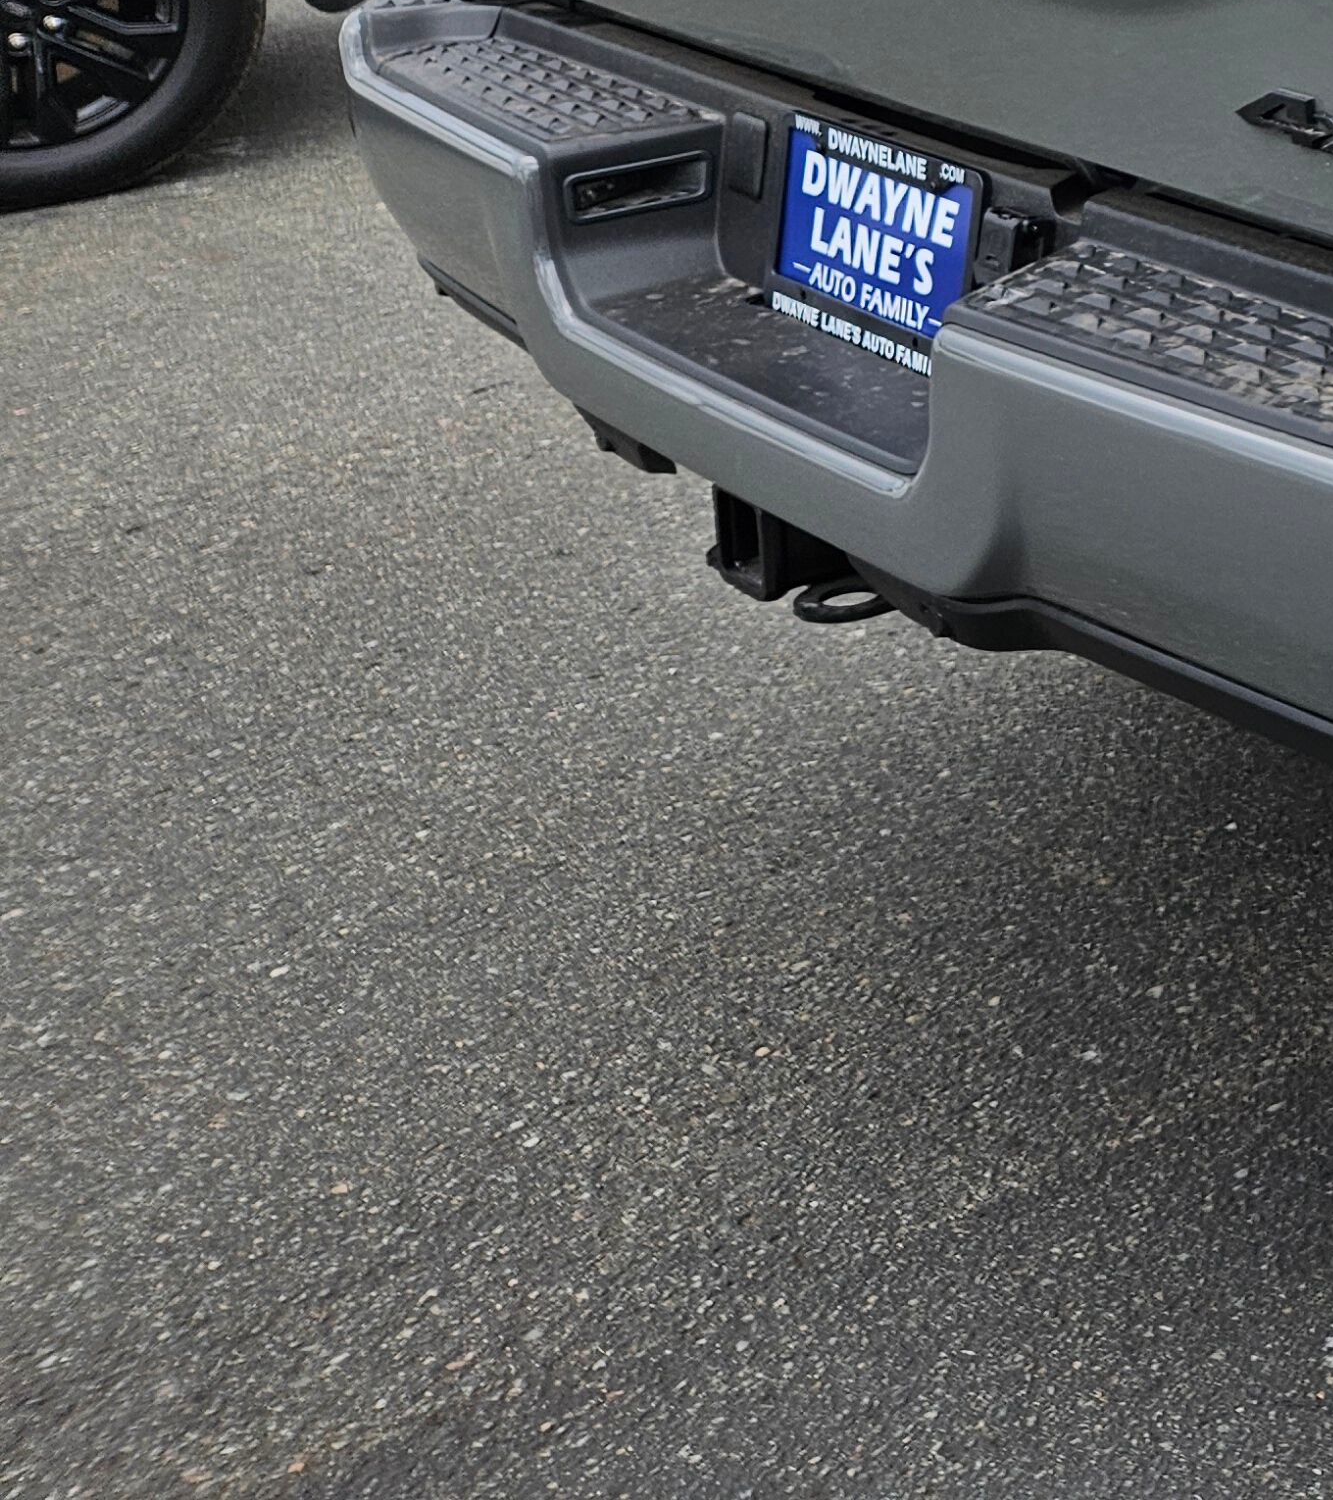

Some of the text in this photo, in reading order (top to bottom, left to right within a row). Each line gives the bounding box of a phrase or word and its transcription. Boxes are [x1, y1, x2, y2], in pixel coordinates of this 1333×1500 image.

[827, 127, 928, 182] DWAYNELANE
[801, 149, 961, 249] DWAYNE
[810, 206, 935, 296] LANE'S
[772, 291, 933, 378] DWAYNE LANE'S AUTO FAMI
[808, 262, 931, 332] AUTO FAMILY
